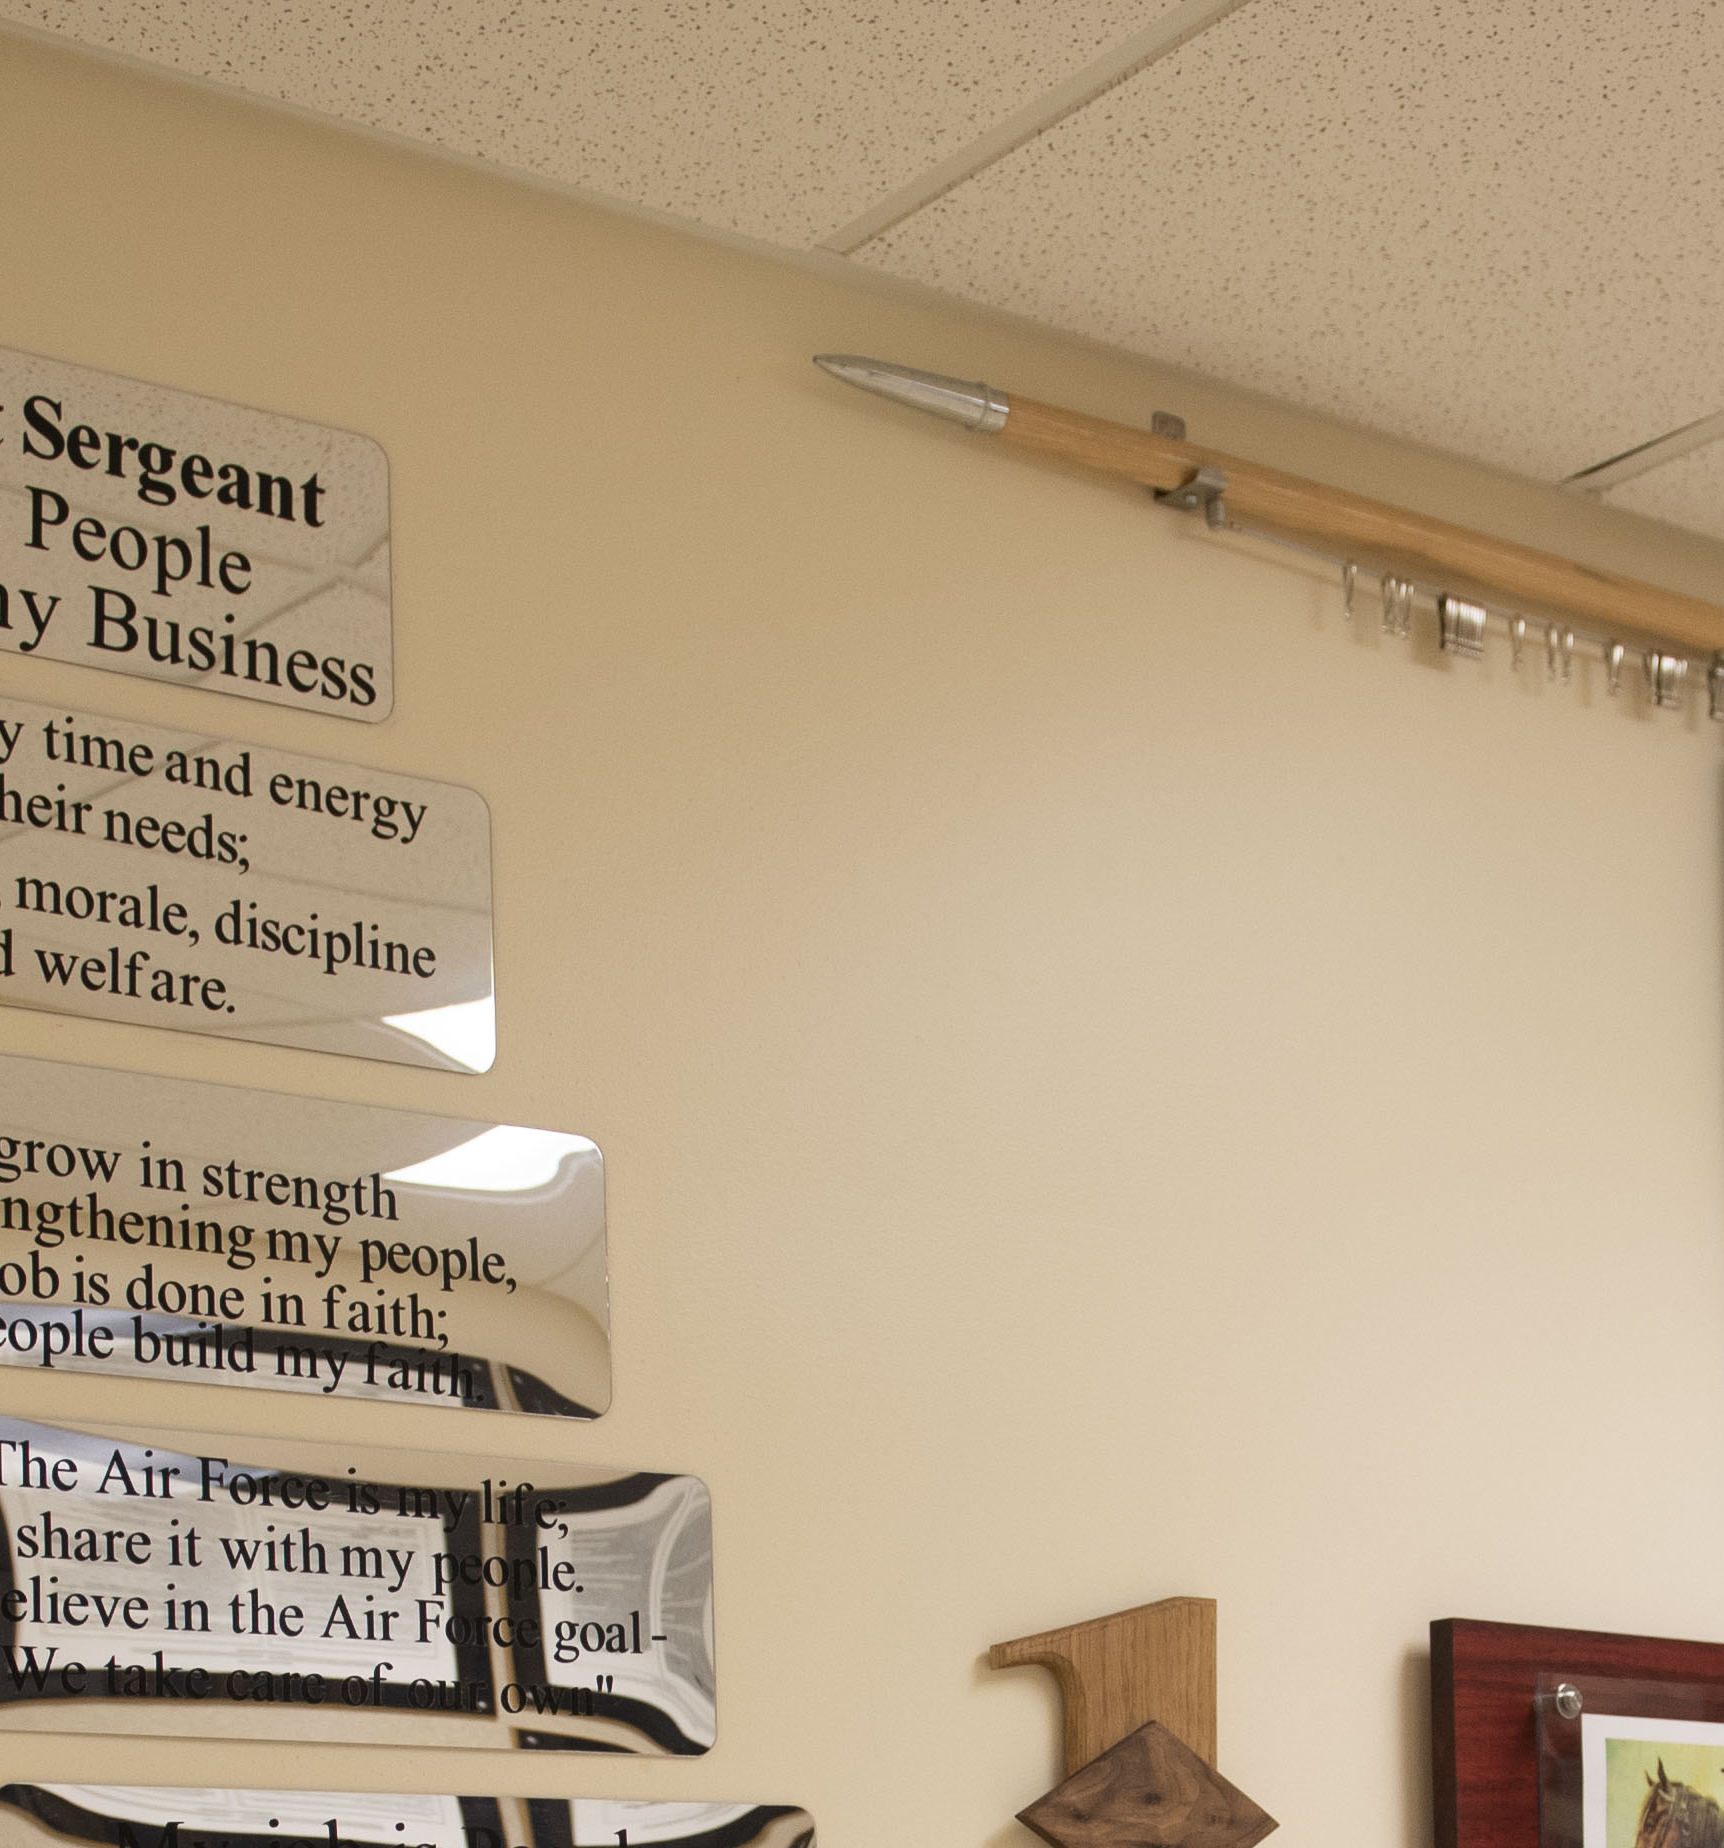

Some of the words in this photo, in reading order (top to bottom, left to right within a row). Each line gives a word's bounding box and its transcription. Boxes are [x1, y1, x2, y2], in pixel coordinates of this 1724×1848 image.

[21, 394, 326, 530] Sergeant
[25, 485, 252, 599] People
[87, 584, 377, 707] Business
[43, 716, 155, 777] time
[164, 743, 253, 798] and
[268, 770, 427, 844] energy
[102, 803, 250, 875] needs;
[14, 872, 202, 946] morale,
[214, 900, 437, 980] discipline
[35, 941, 236, 1014] welfare.
[139, 1141, 187, 1191] in
[202, 1166, 398, 1223] strength
[72, 1258, 109, 1306] is
[125, 1262, 245, 1321] done
[261, 1277, 306, 1327] in
[321, 1284, 450, 1348] faith;
[266, 1225, 341, 1279] my
[359, 1232, 519, 1294] people,
[132, 1312, 258, 1375] build
[273, 1344, 348, 1392] my
[363, 1338, 486, 1403] faith.
[97, 1449, 181, 1501] Air
[198, 1456, 330, 1513] Force
[347, 1467, 383, 1517] is
[395, 1483, 469, 1536] my
[480, 1477, 570, 1539] life;
[15, 1515, 151, 1567] share
[167, 1521, 202, 1569] it
[220, 1522, 328, 1577] with
[339, 1538, 414, 1593] my
[434, 1531, 585, 1597] people.
[164, 1585, 211, 1633] in
[229, 1587, 304, 1639] the
[320, 1593, 399, 1645] Air
[415, 1598, 540, 1651] Force
[102, 1652, 212, 1702] take
[225, 1669, 327, 1706] care
[340, 1661, 393, 1708] of
[407, 1677, 488, 1714] our
[500, 1673, 614, 1718] own"
